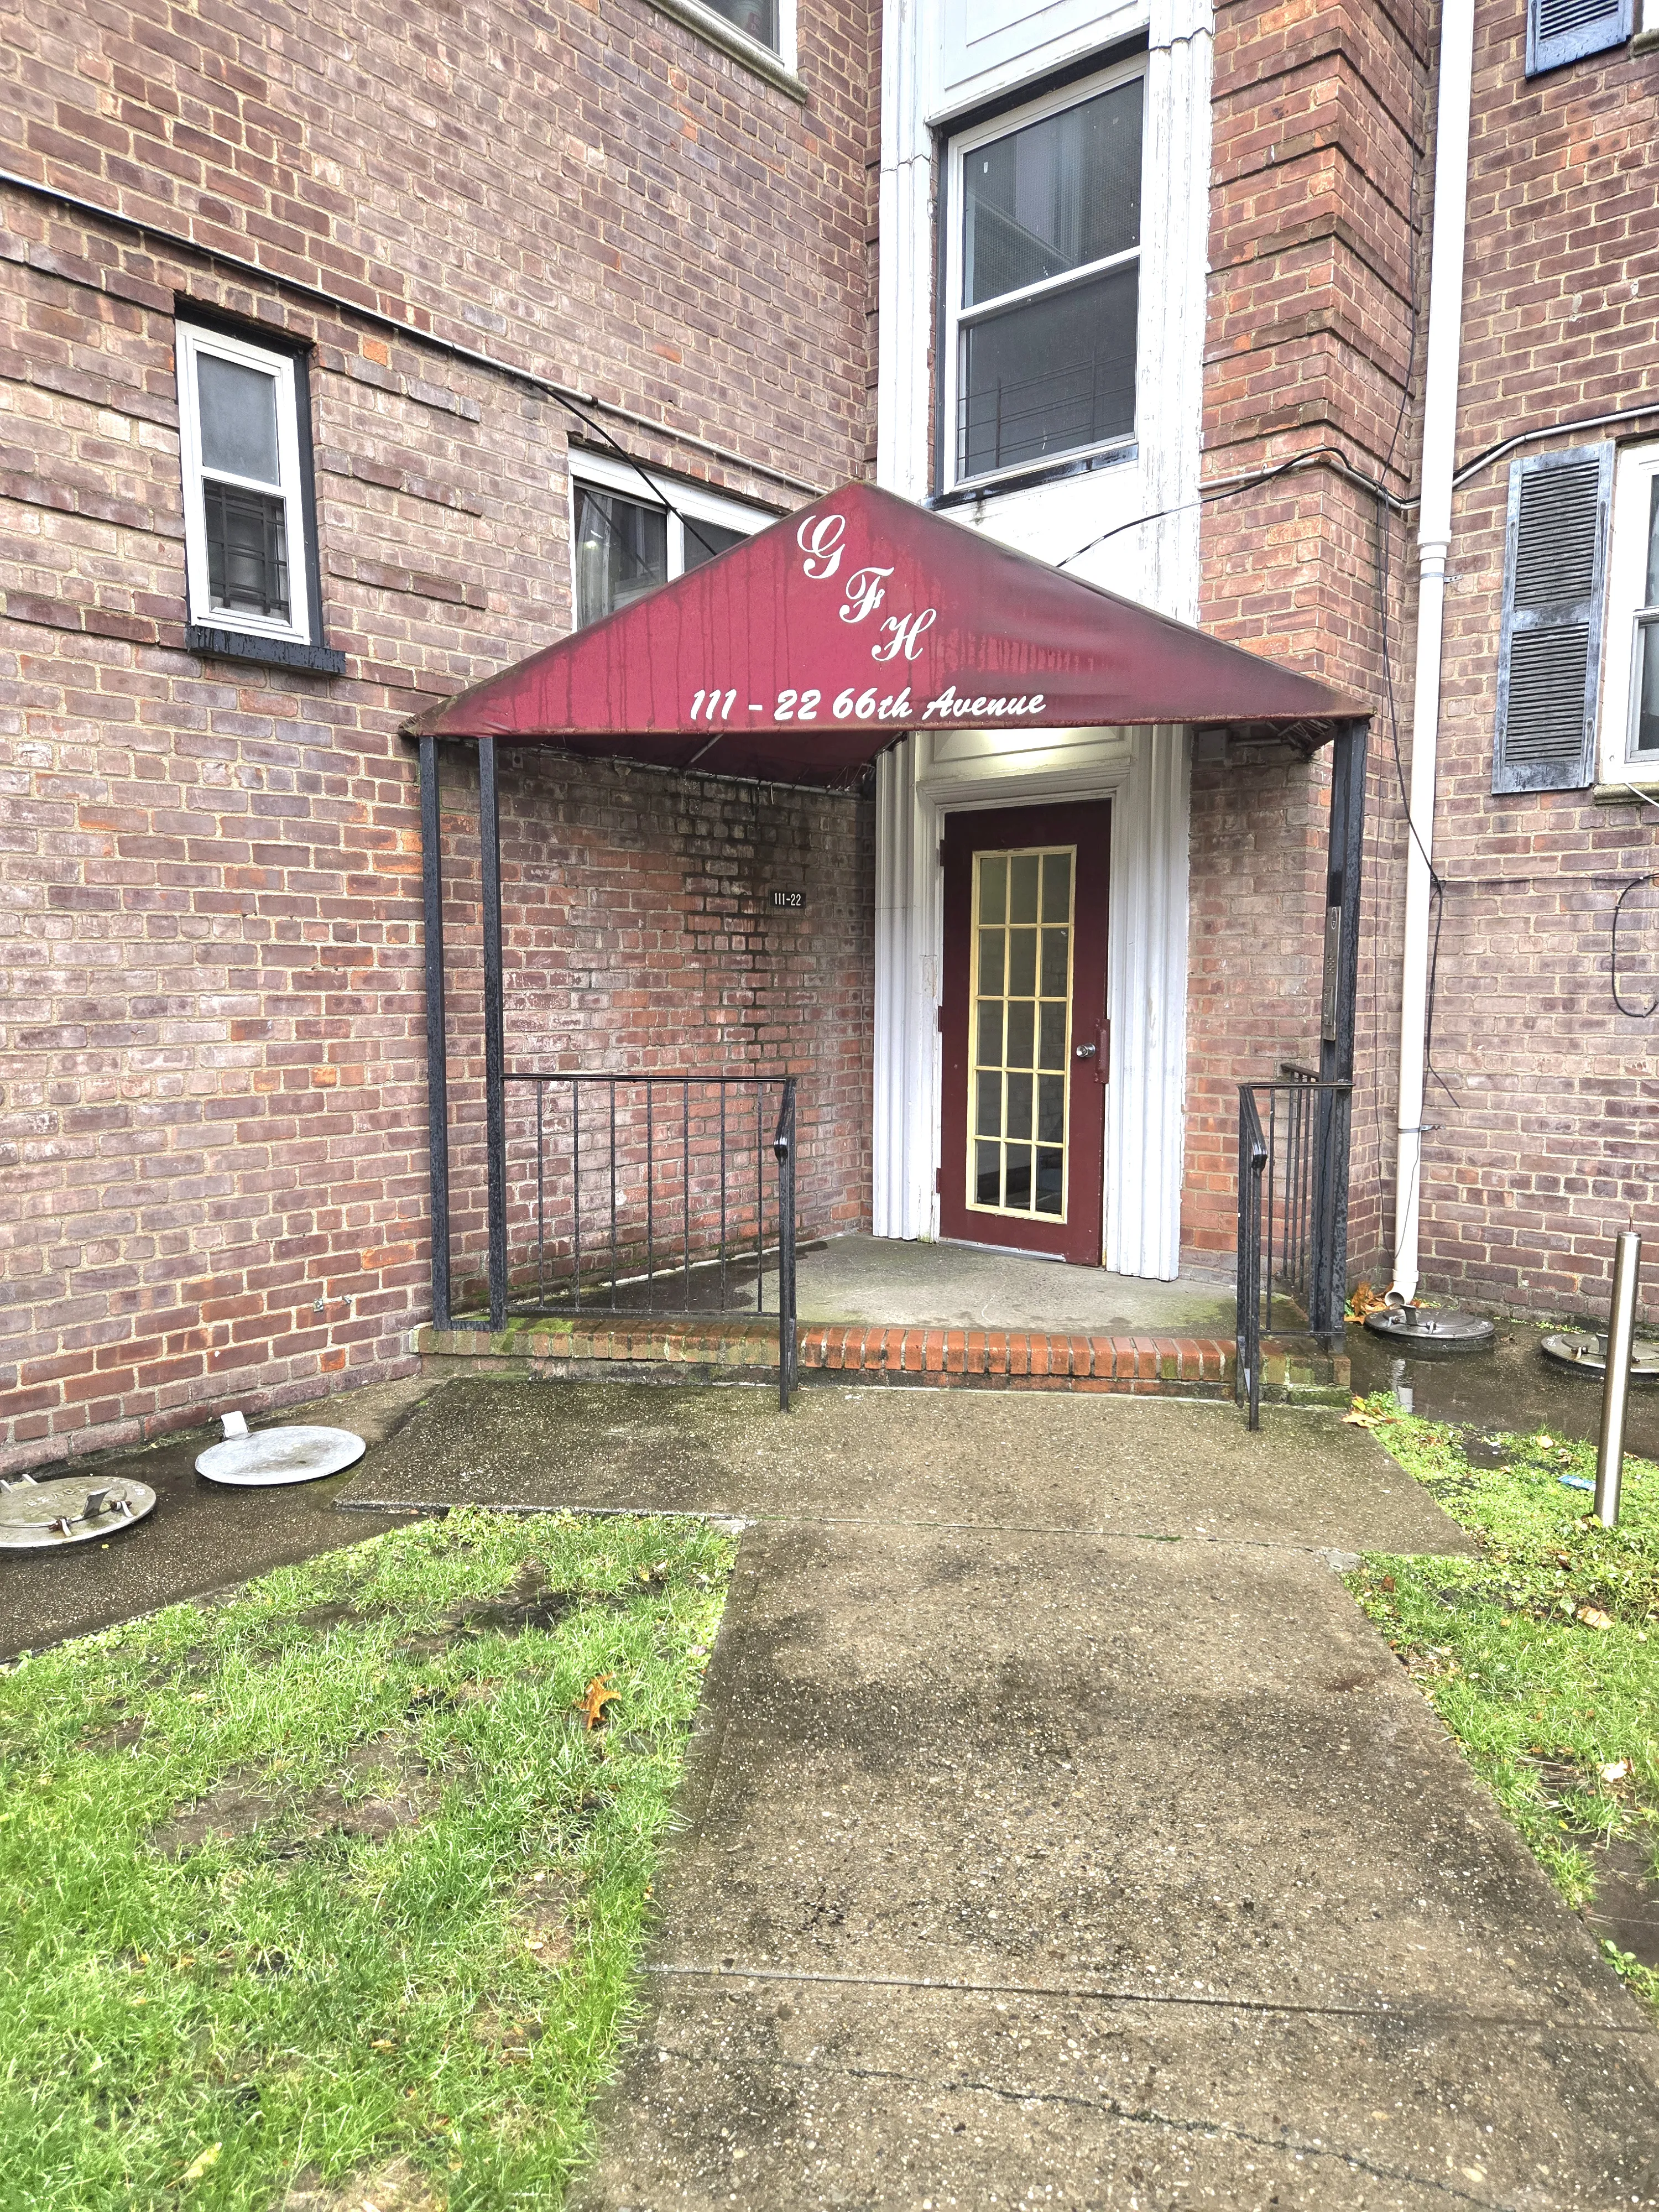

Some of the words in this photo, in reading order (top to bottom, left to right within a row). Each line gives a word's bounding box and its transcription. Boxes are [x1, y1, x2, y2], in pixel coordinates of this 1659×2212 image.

[797, 514, 846, 579] G
[839, 567, 895, 623] F
[871, 608, 937, 661] H
[690, 689, 737, 720] 111
[774, 689, 821, 721] 22
[832, 687, 913, 720] 66th
[921, 685, 1046, 721] Avenue
[774, 893, 801, 906] 111-22
